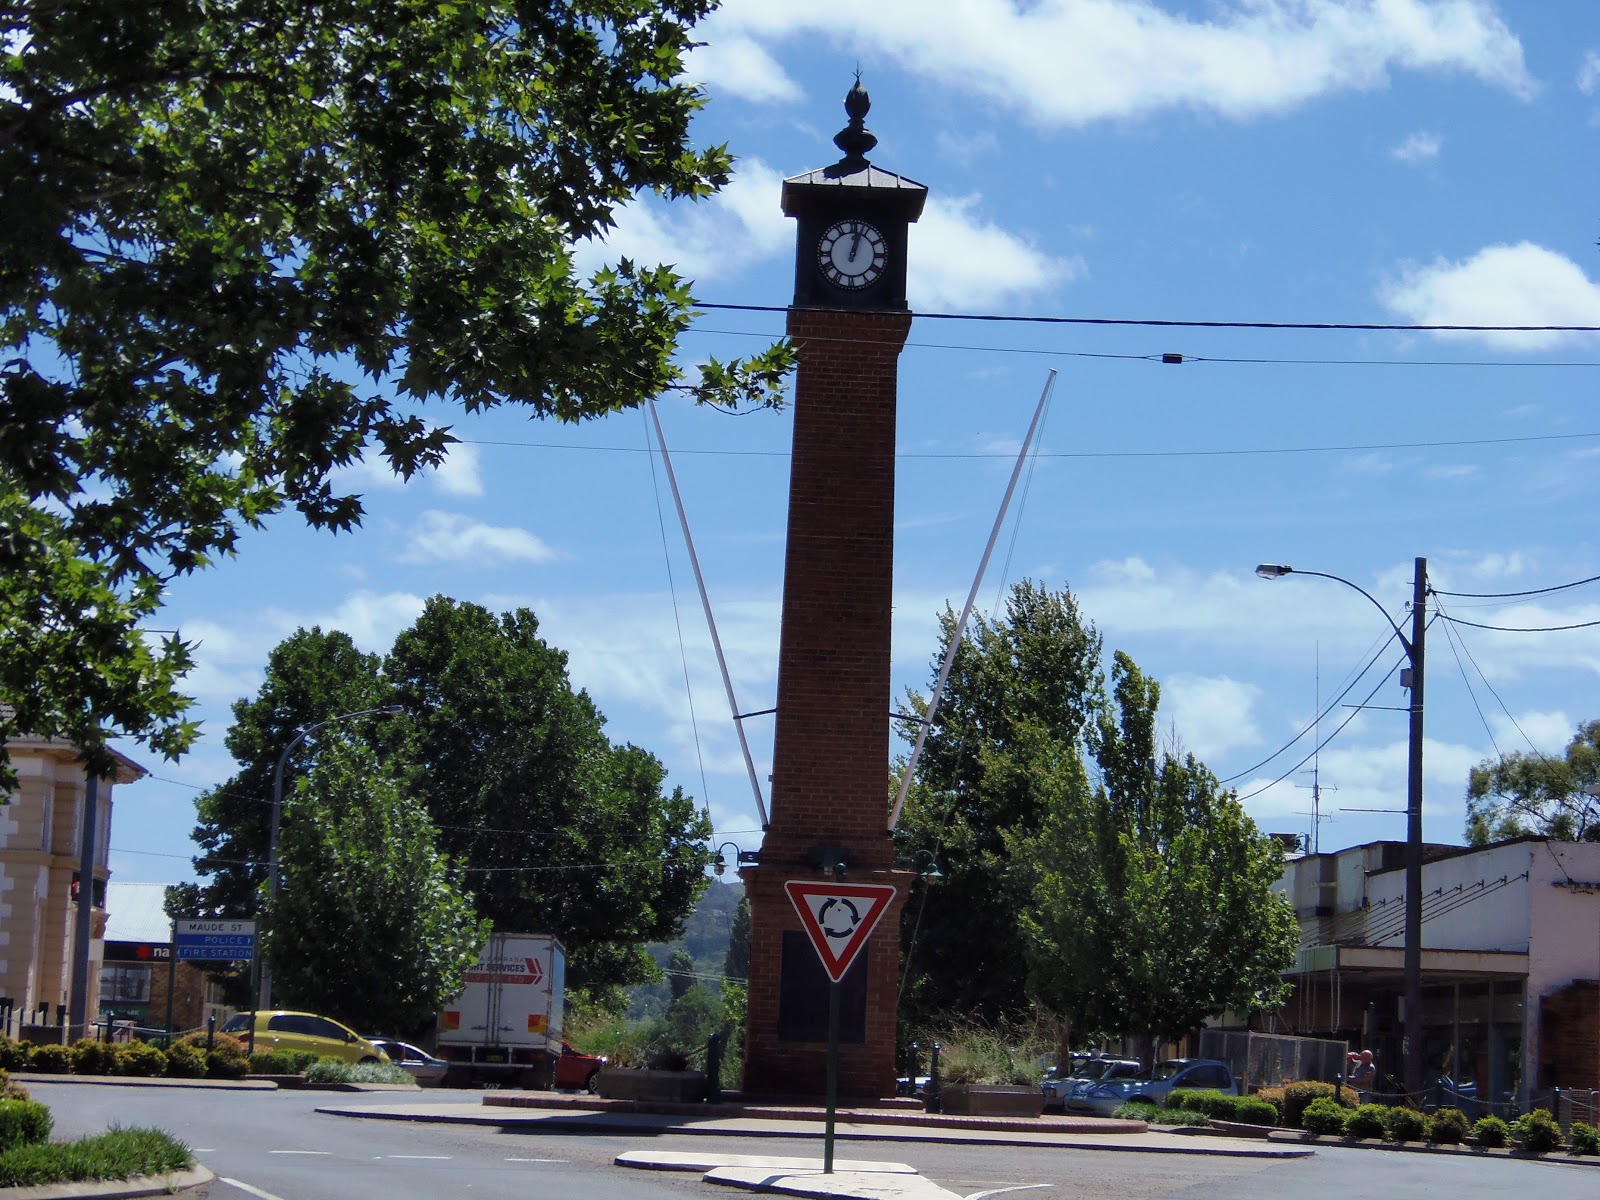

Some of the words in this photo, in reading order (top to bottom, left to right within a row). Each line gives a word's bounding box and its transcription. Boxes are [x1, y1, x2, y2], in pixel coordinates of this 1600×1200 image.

[189, 923, 224, 932] MAUDE
[231, 924, 243, 932] ST
[205, 936, 243, 944] POLICE
[153, 947, 170, 957] na
[184, 949, 206, 957] FIRE
[210, 949, 251, 957] STATION
[486, 963, 525, 973] SERVICES
